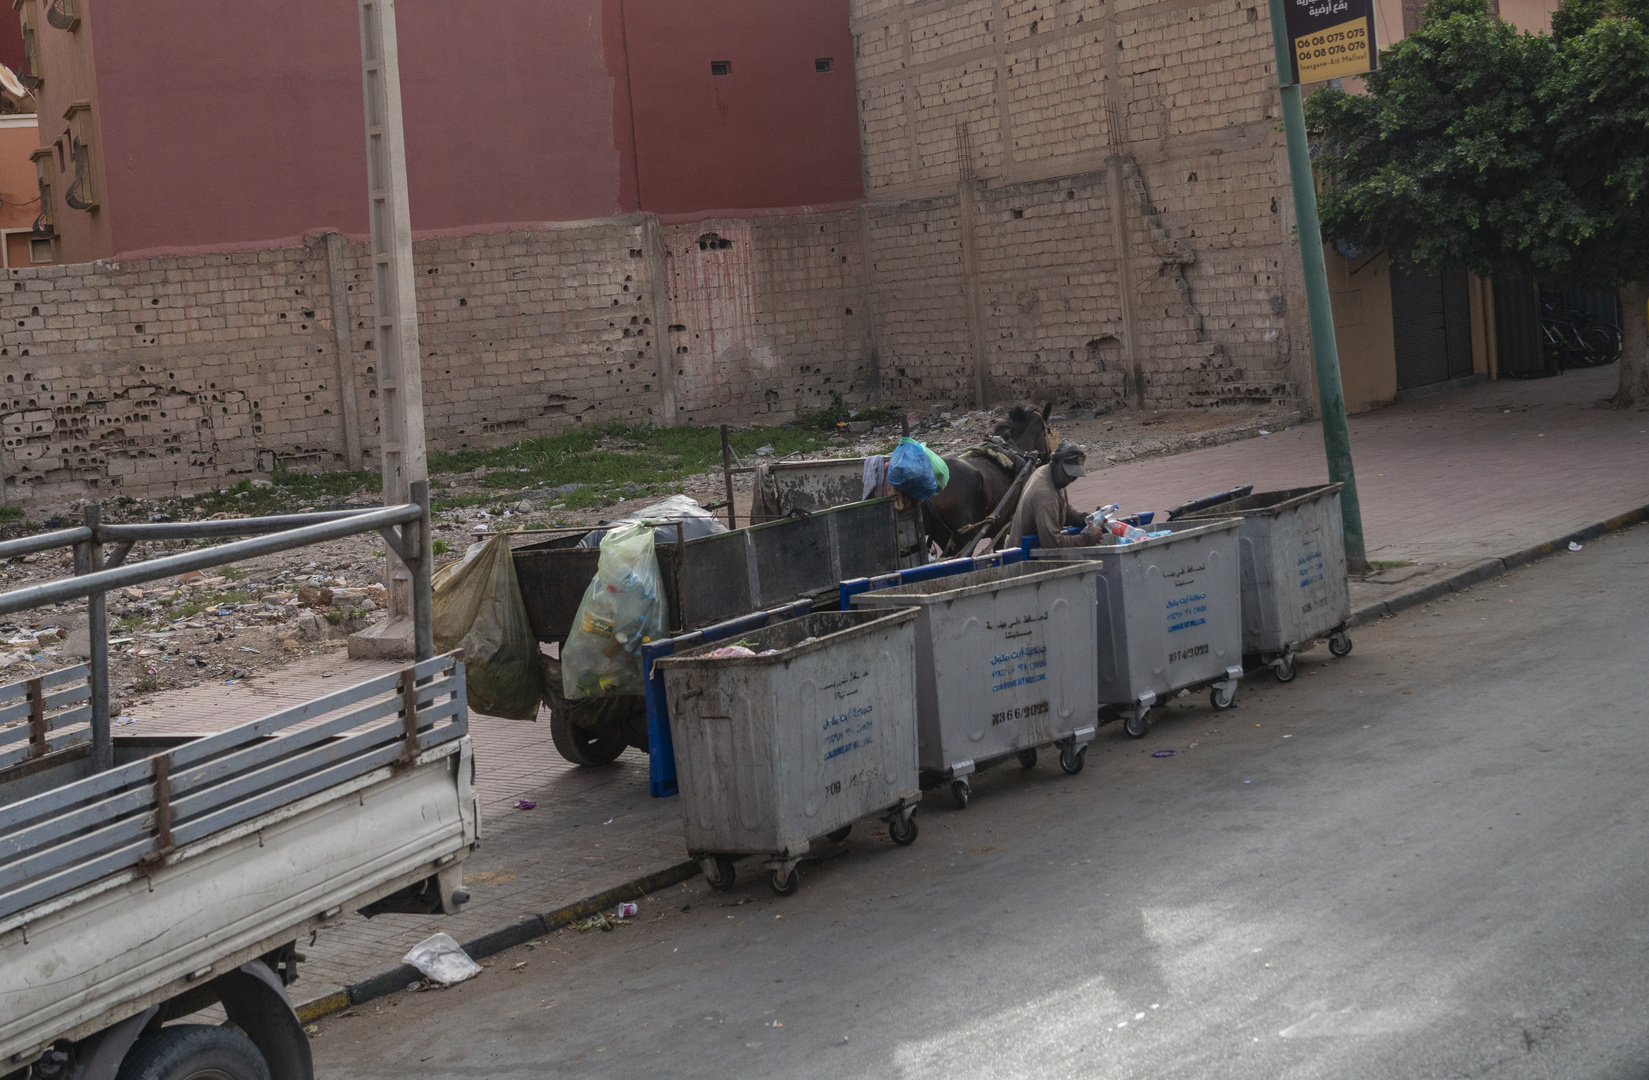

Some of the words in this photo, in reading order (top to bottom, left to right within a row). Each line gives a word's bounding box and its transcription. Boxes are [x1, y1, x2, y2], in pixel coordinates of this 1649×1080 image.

[1309, 0, 1332, 16] أرضية
[1333, 0, 1348, 13] بقع
[1297, 39, 1310, 49] 06
[1312, 36, 1325, 46] 08
[1327, 32, 1345, 43] 075
[1347, 28, 1365, 39] 075
[1299, 51, 1312, 60] 06
[1314, 48, 1327, 58] 08
[1328, 45, 1346, 55] 076
[1348, 41, 1366, 51] 076
